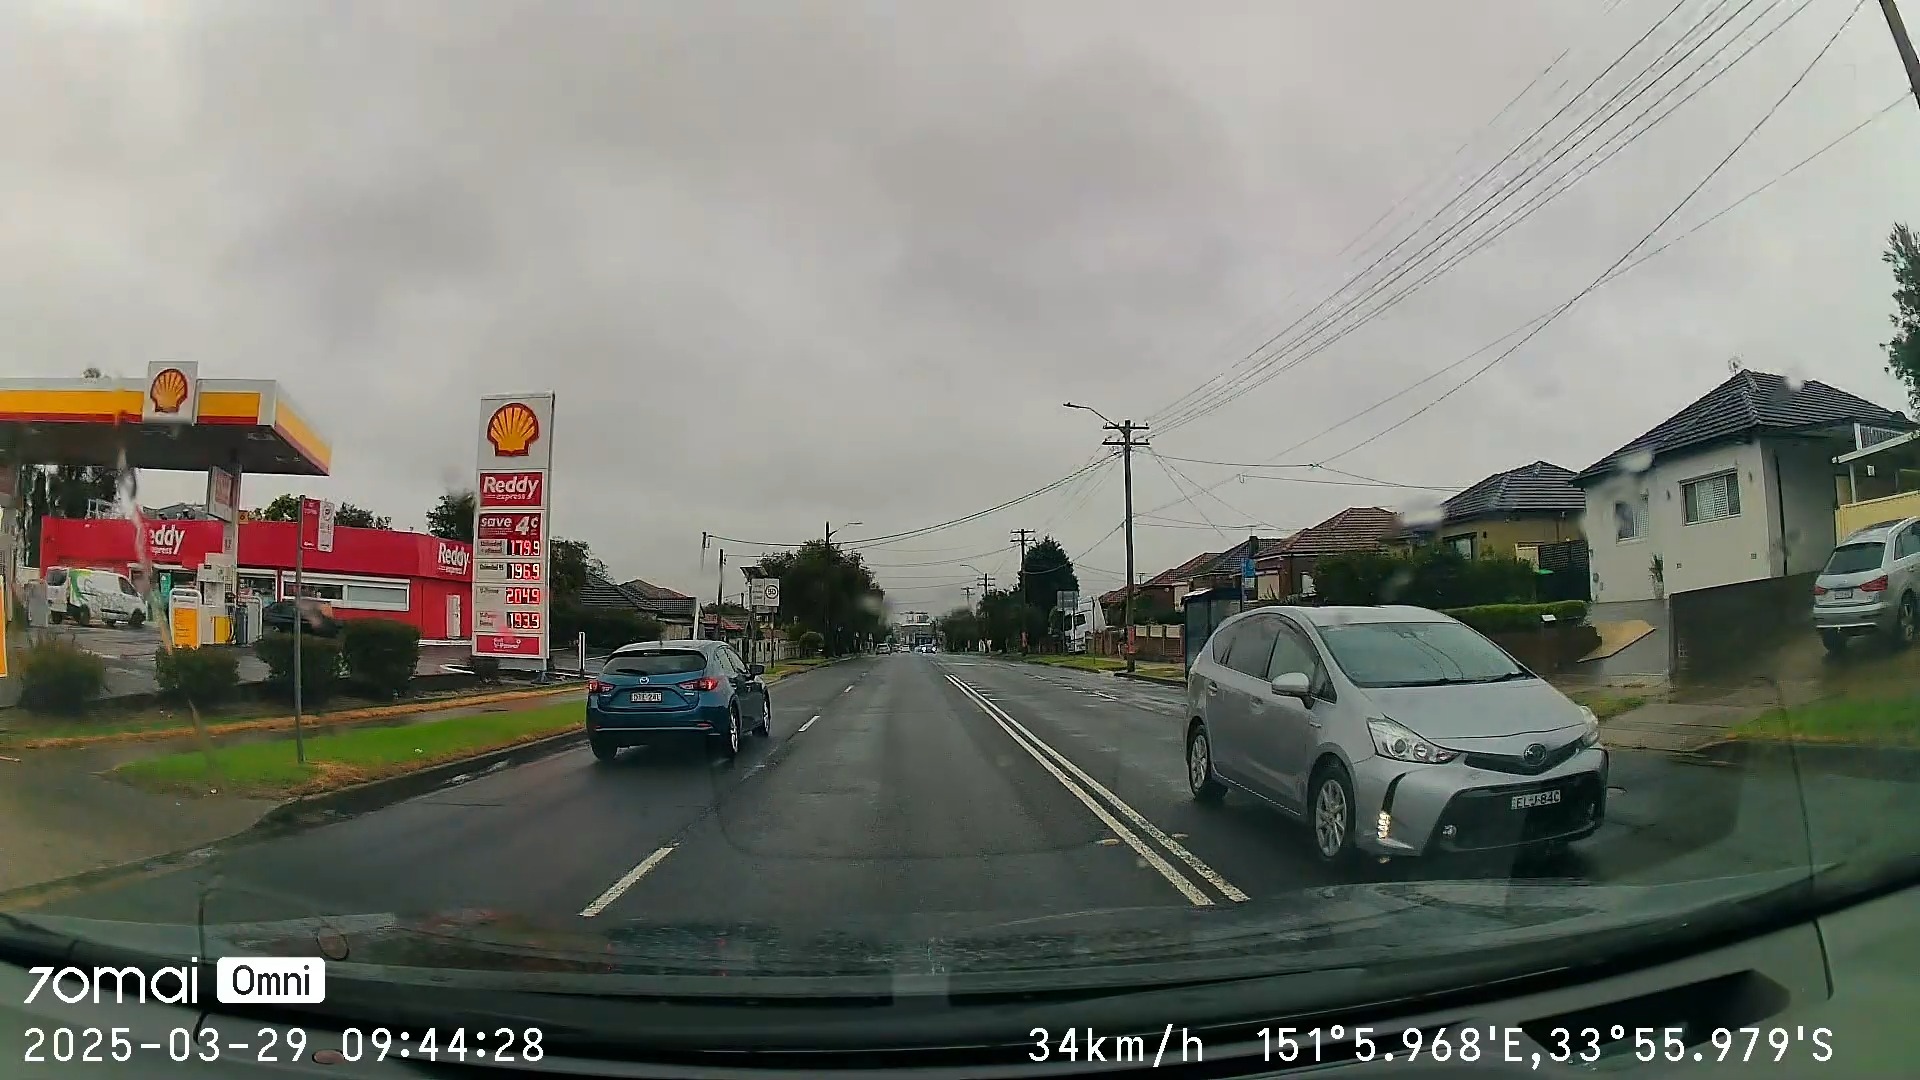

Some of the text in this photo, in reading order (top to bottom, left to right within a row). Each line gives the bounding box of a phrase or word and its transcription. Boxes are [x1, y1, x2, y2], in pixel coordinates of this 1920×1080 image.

[483, 476, 540, 499] Reddy
[481, 517, 512, 528] save
[148, 524, 186, 555] eddy
[438, 542, 470, 576] Reddy
